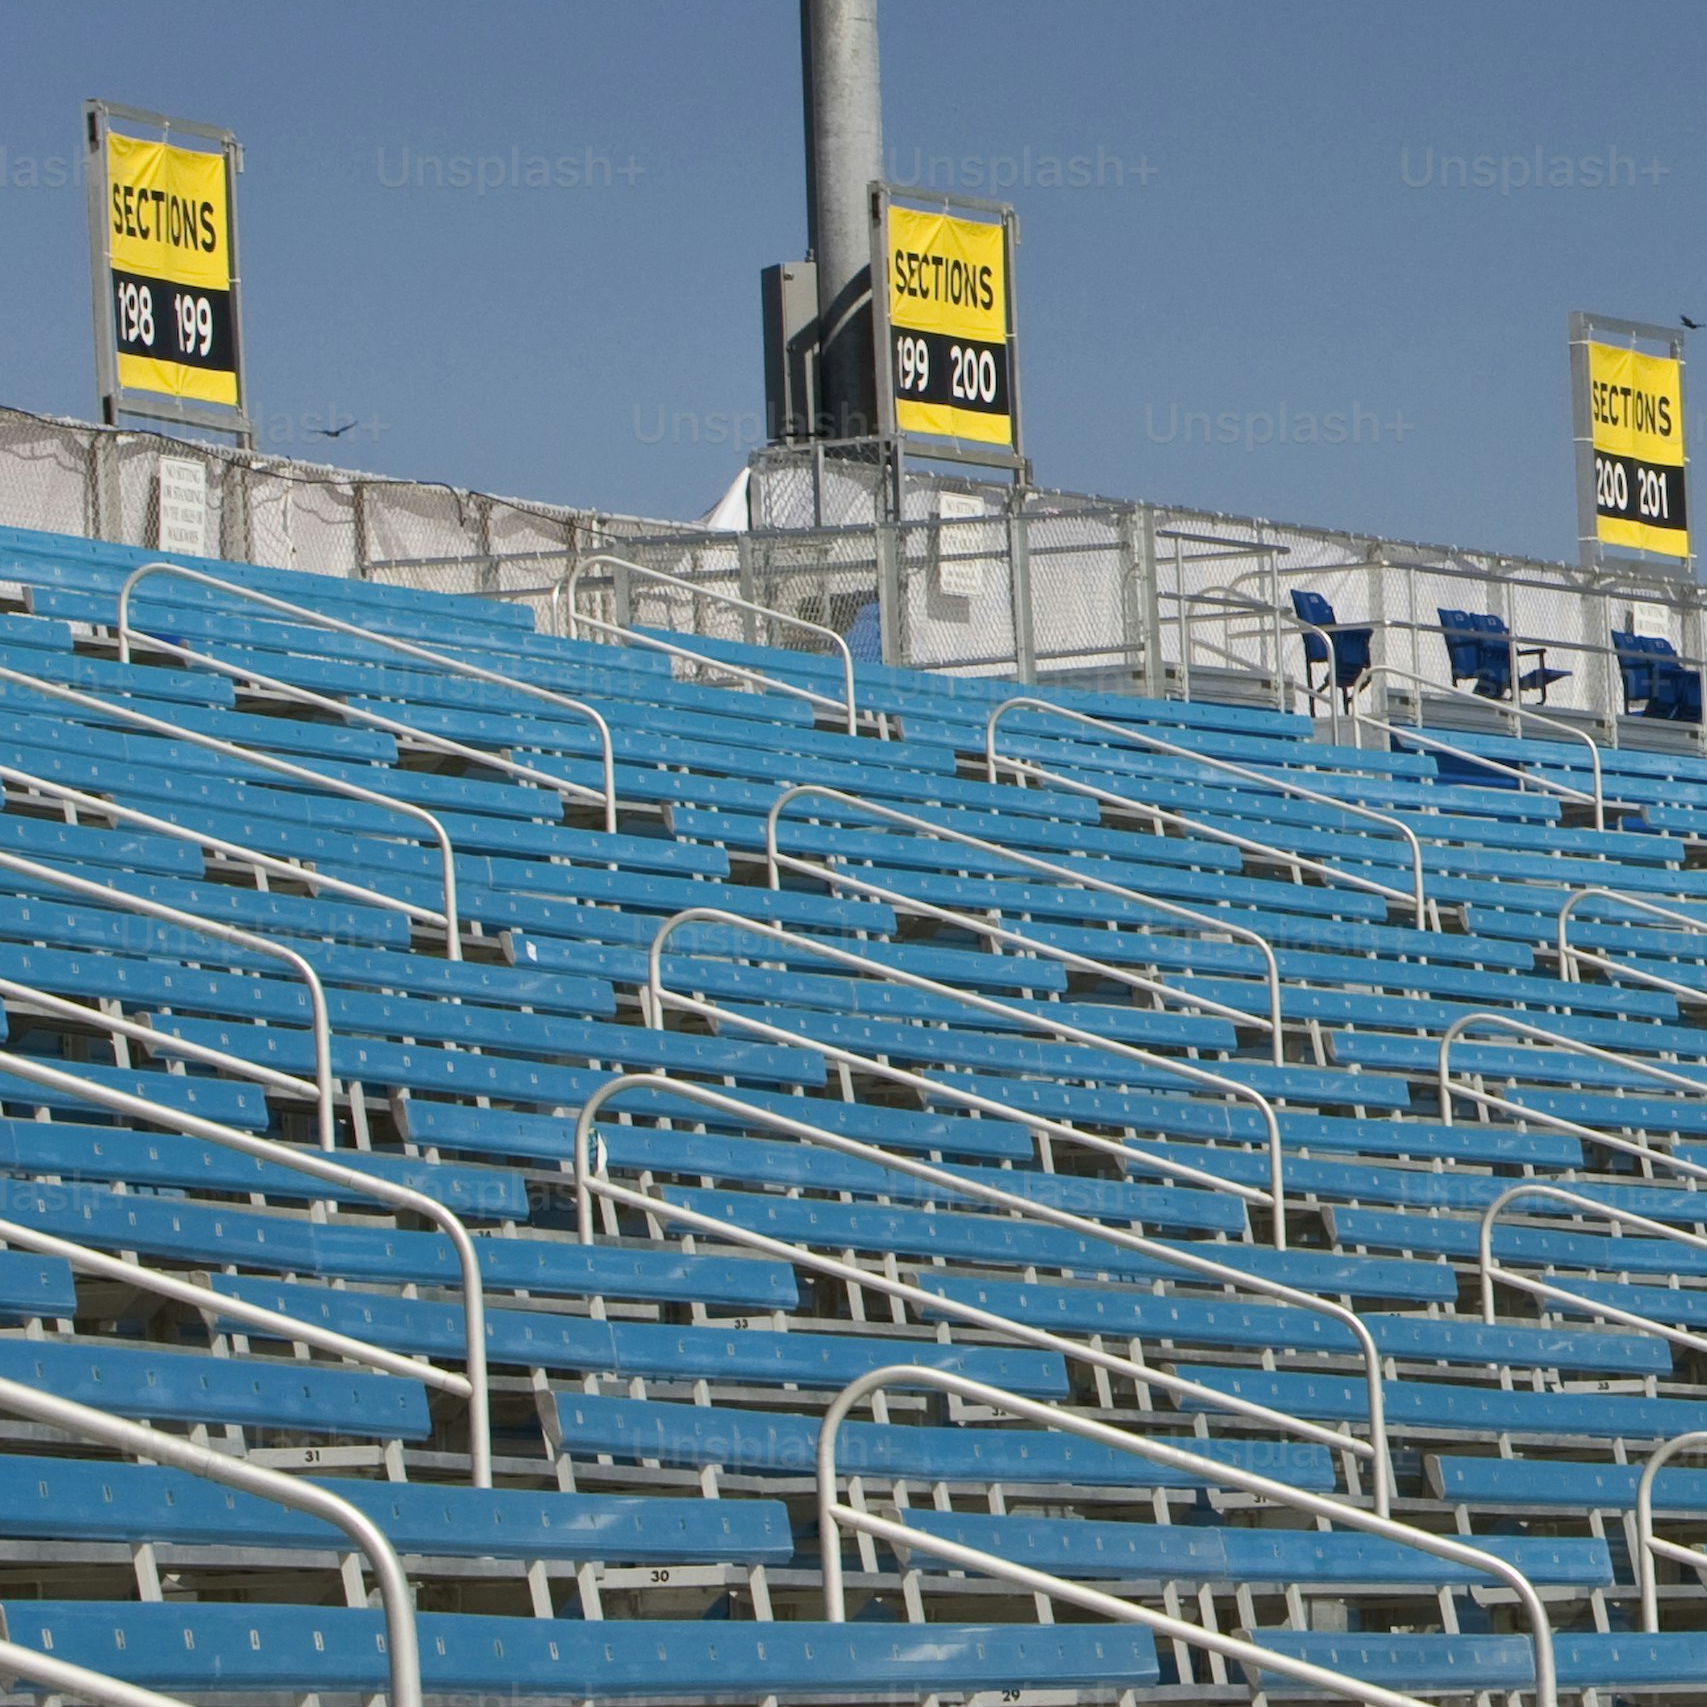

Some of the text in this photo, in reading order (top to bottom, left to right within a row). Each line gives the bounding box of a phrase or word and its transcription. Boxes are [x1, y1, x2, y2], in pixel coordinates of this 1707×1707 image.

[113, 183, 216, 253] SECTIONS
[895, 249, 994, 311] SECTIONS
[118, 281, 213, 357] 198 199
[897, 336, 996, 403] 199 200
[1593, 380, 1672, 437] SECTIONS
[1596, 458, 1669, 519] 200 201
[734, 1319, 749, 1330] 33
[304, 1450, 321, 1463] 31
[651, 1570, 670, 1583] 30
[1002, 1690, 1021, 1703] 29
